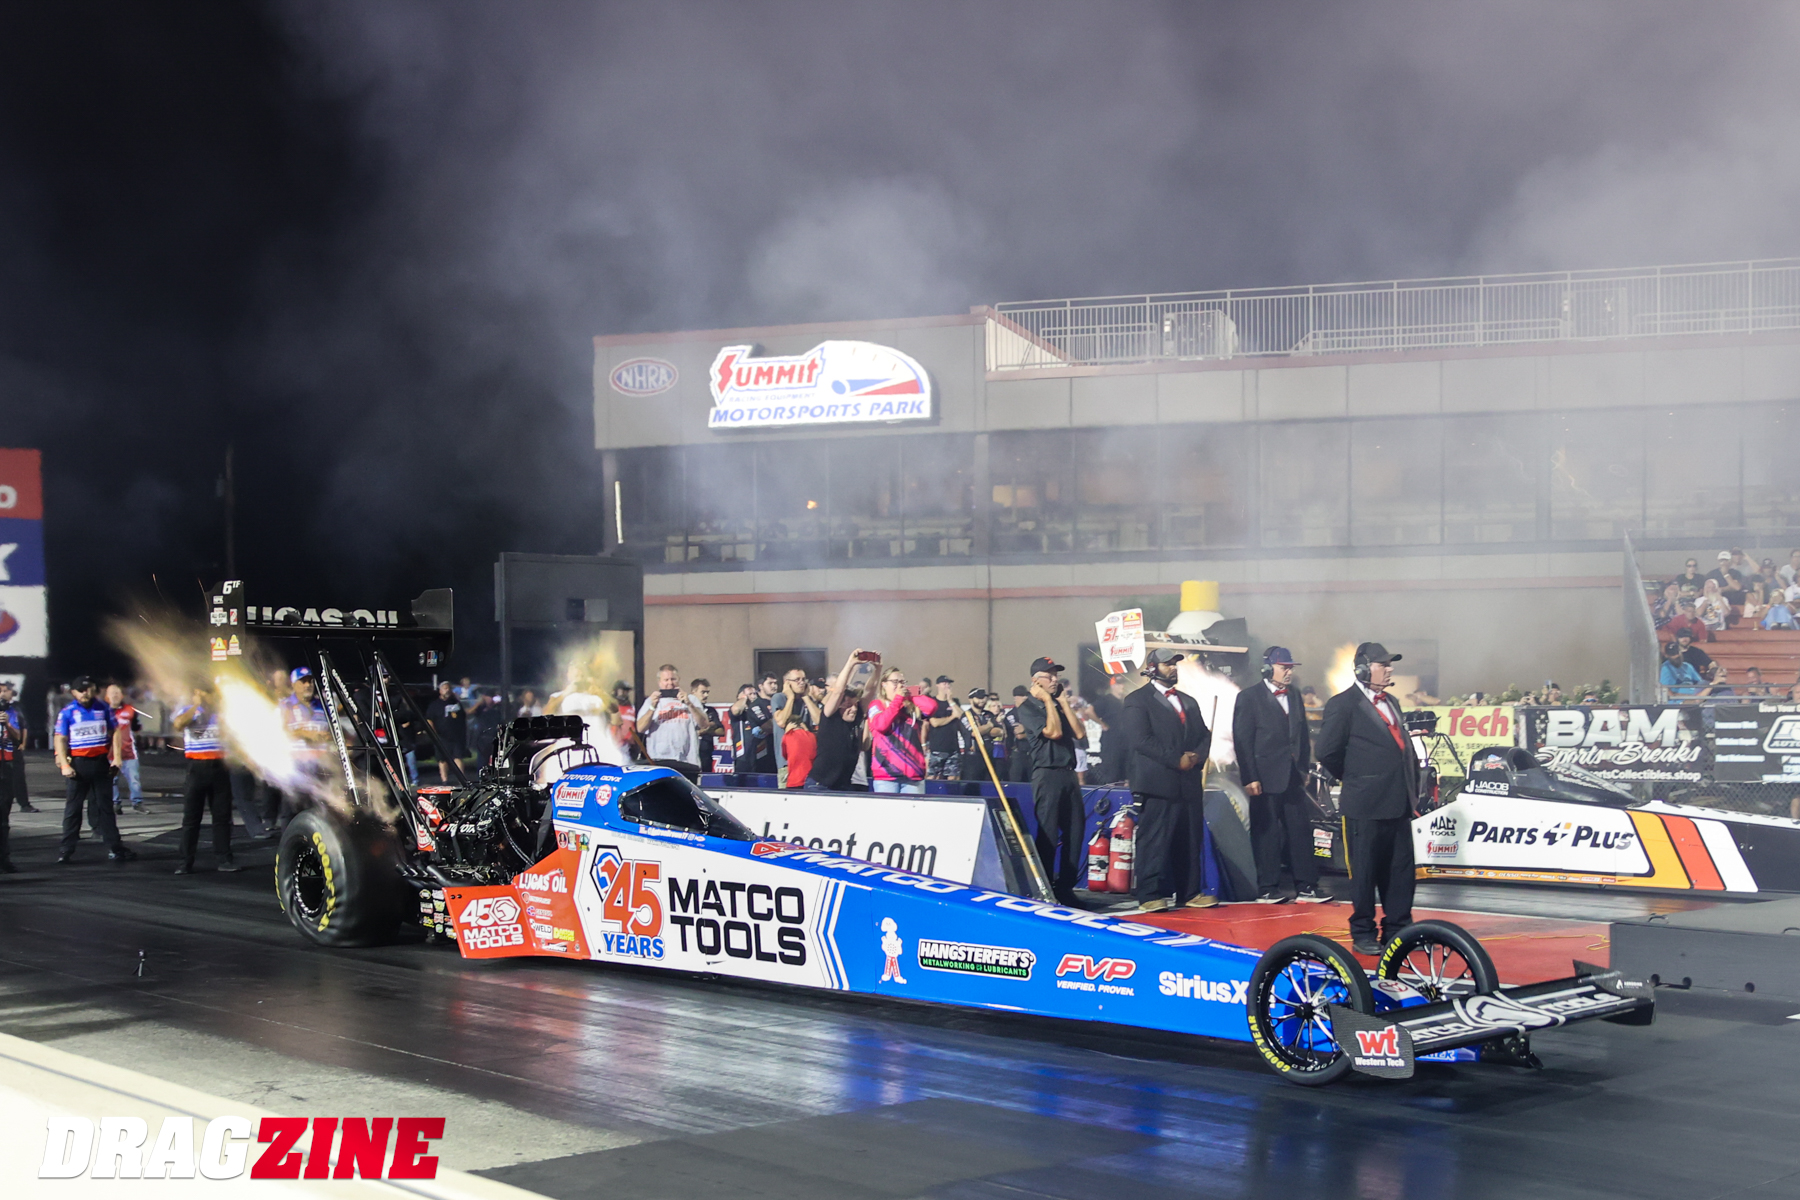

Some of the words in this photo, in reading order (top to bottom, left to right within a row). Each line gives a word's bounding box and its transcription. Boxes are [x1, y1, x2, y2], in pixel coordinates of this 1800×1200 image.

[619, 370, 670, 390] NHRA
[712, 402, 861, 424] MOTORSPORTS
[869, 400, 925, 416] PARK
[1448, 707, 1509, 737] Tech
[1545, 708, 1681, 747] BAM
[1534, 745, 1604, 769] Sports
[1611, 741, 1702, 766] Breaks
[567, 773, 597, 782] TOYOTA
[1475, 780, 1509, 791] JACOB
[1430, 815, 1454, 831] MAC
[1467, 821, 1539, 845] PARTS
[1571, 825, 1635, 850] PLUS
[519, 873, 551, 892] LUCAS
[551, 876, 568, 893] OIL
[792, 851, 970, 893] MATCO
[971, 891, 1167, 937] TOOLS
[602, 860, 664, 938] 45
[668, 876, 805, 925] MATCO
[463, 924, 523, 941] MATCO
[535, 924, 552, 934] WELD
[670, 914, 807, 966] TOOLS
[465, 934, 524, 950] TOOLS
[603, 932, 665, 959] YEARS
[920, 942, 1034, 968] HANGSTERFER'S
[1056, 954, 1136, 980] FVP
[922, 958, 976, 971] METALWORKING
[983, 965, 1028, 977] LUBRICANTS
[1056, 979, 1096, 992] VERIFIED.
[1098, 984, 1135, 996] PROVEN.
[1158, 971, 1250, 1005] SiriusX
[1537, 992, 1622, 1012] TOOLS
[1411, 1022, 1474, 1041] ATCO
[1248, 1015, 1291, 1073] GOODYEAR
[1354, 1057, 1386, 1067] Western
[1387, 1057, 1405, 1067] Tech
